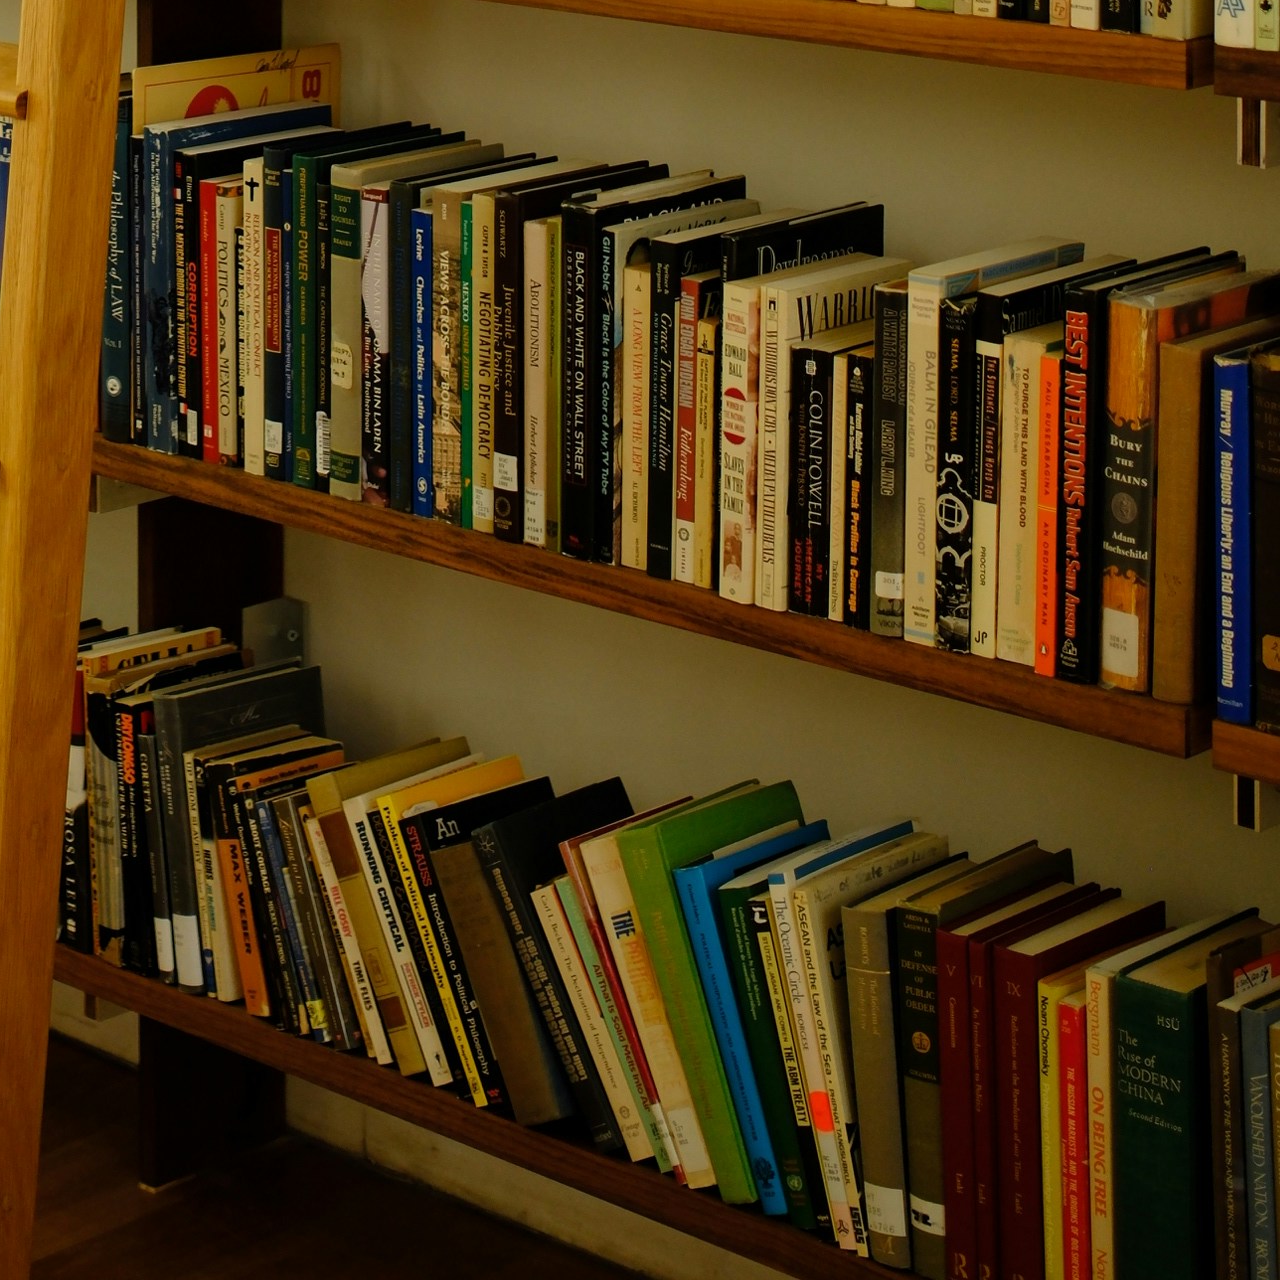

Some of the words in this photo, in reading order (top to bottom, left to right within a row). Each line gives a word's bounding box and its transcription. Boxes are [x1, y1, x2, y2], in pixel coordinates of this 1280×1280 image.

[575, 251, 585, 293] BLACK
[575, 294, 585, 321] AND
[479, 291, 491, 377] NEGOTIATING
[574, 326, 584, 367] WHITE
[1065, 310, 1088, 367] BEST
[479, 383, 491, 460] DEMOCRACY
[574, 392, 584, 427] WALL
[808, 390, 823, 446] COLIN
[1062, 368, 1088, 508] INTENTIONS
[1115, 456, 1134, 467] THE
[808, 453, 823, 529] POWELL
[228, 843, 242, 883] MAX
[406, 825, 432, 888] STRAUSS
[354, 821, 381, 884] RUNNING
[378, 887, 405, 953] CRITICAL
[233, 893, 253, 954] WEBER
[352, 960, 365, 986] TIME
[360, 986, 373, 1010] FLIES
[1040, 995, 1049, 1024] Noam
[1041, 1025, 1050, 1077] Chomsky
[1092, 1086, 1106, 1116] ON
[1093, 1120, 1106, 1175] BEING
[1095, 1178, 1108, 1218] FREE
